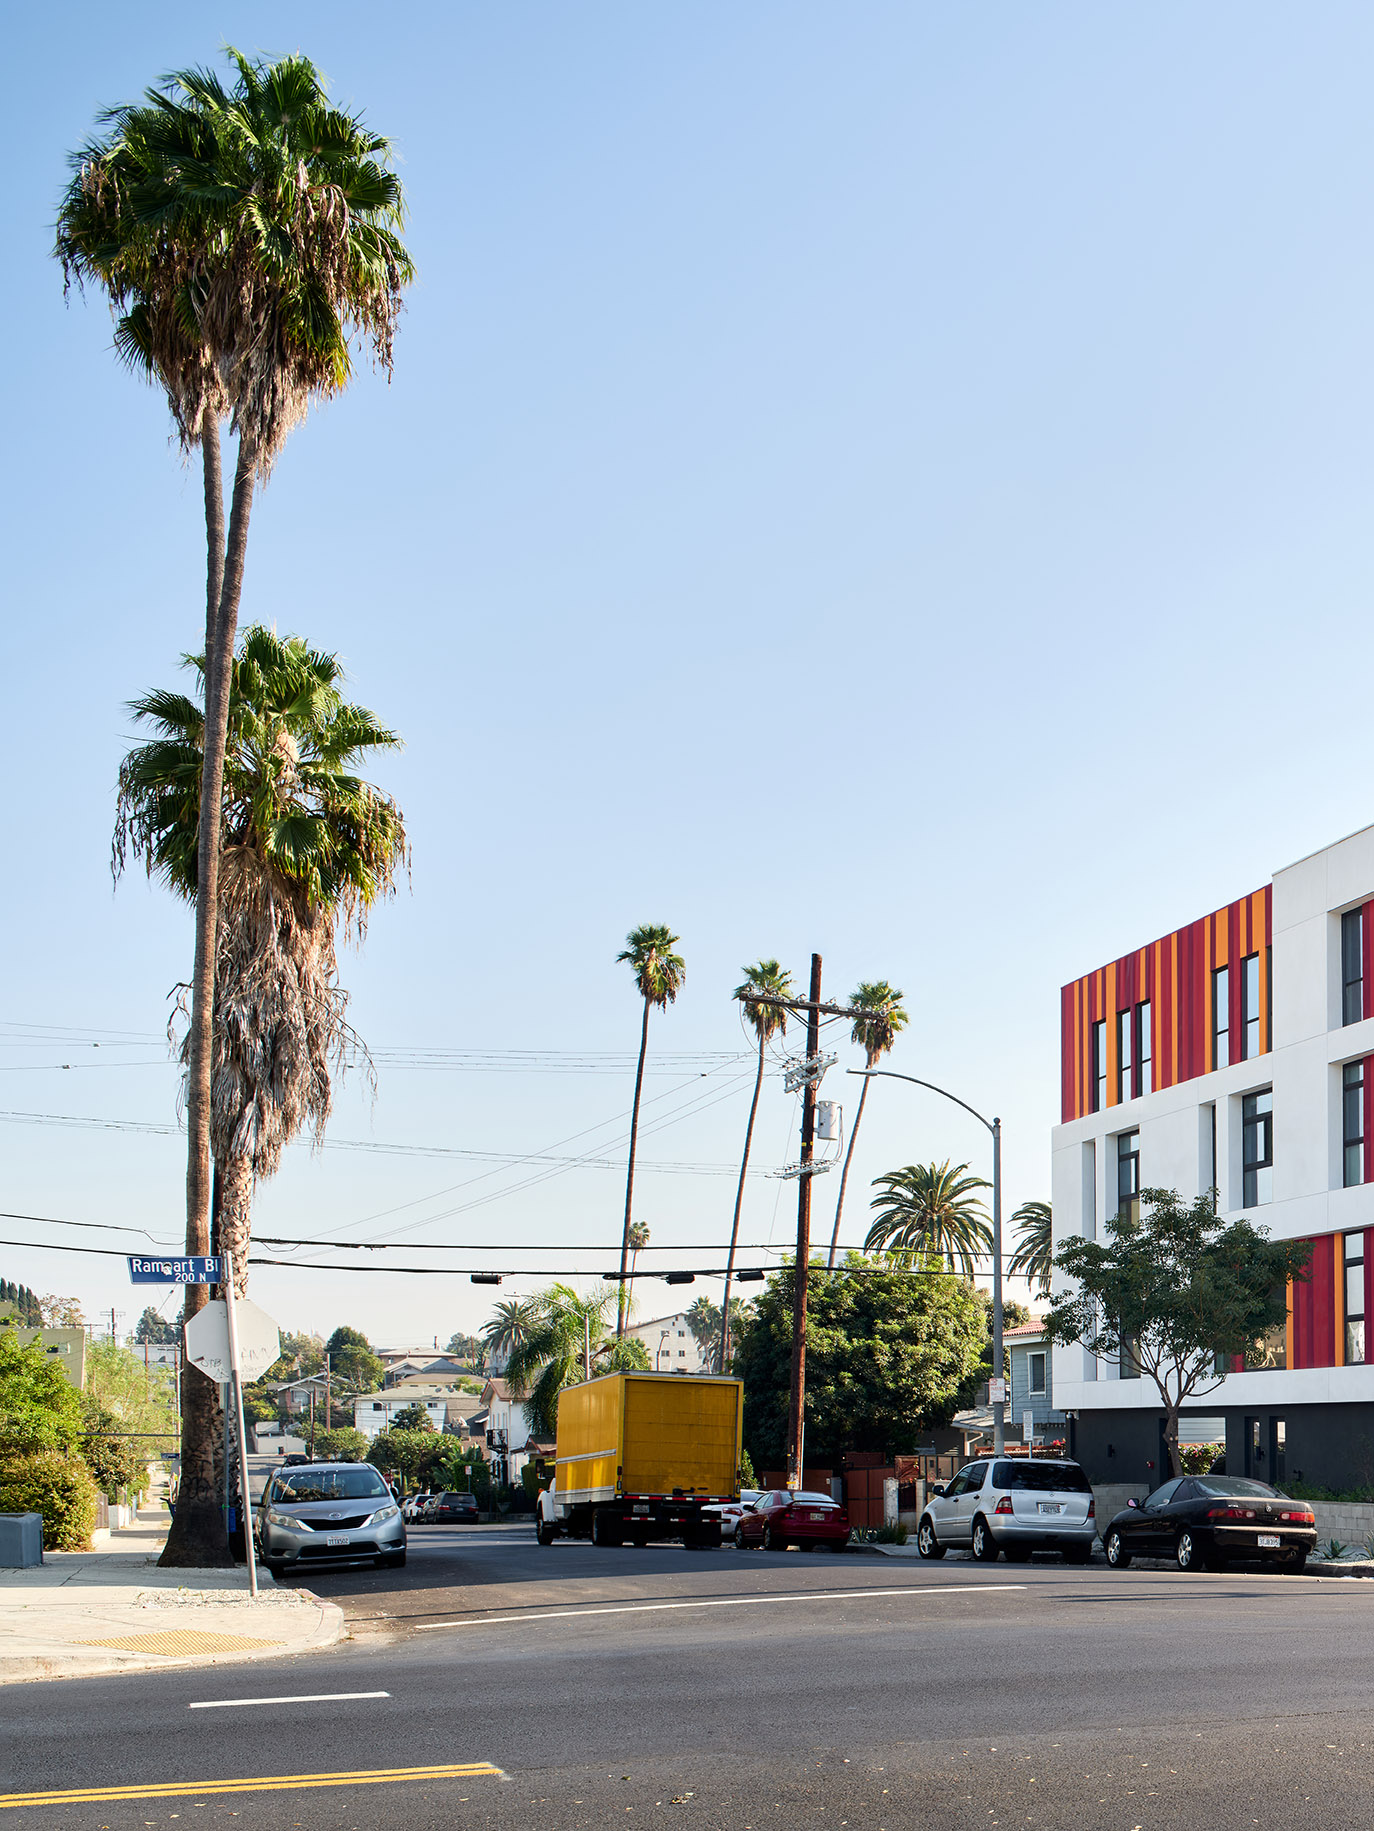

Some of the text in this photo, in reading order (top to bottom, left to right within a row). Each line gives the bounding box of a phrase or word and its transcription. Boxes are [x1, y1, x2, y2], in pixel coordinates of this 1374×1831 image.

[204, 1258, 219, 1272] Bl
[174, 1272, 207, 1282] 200 N
